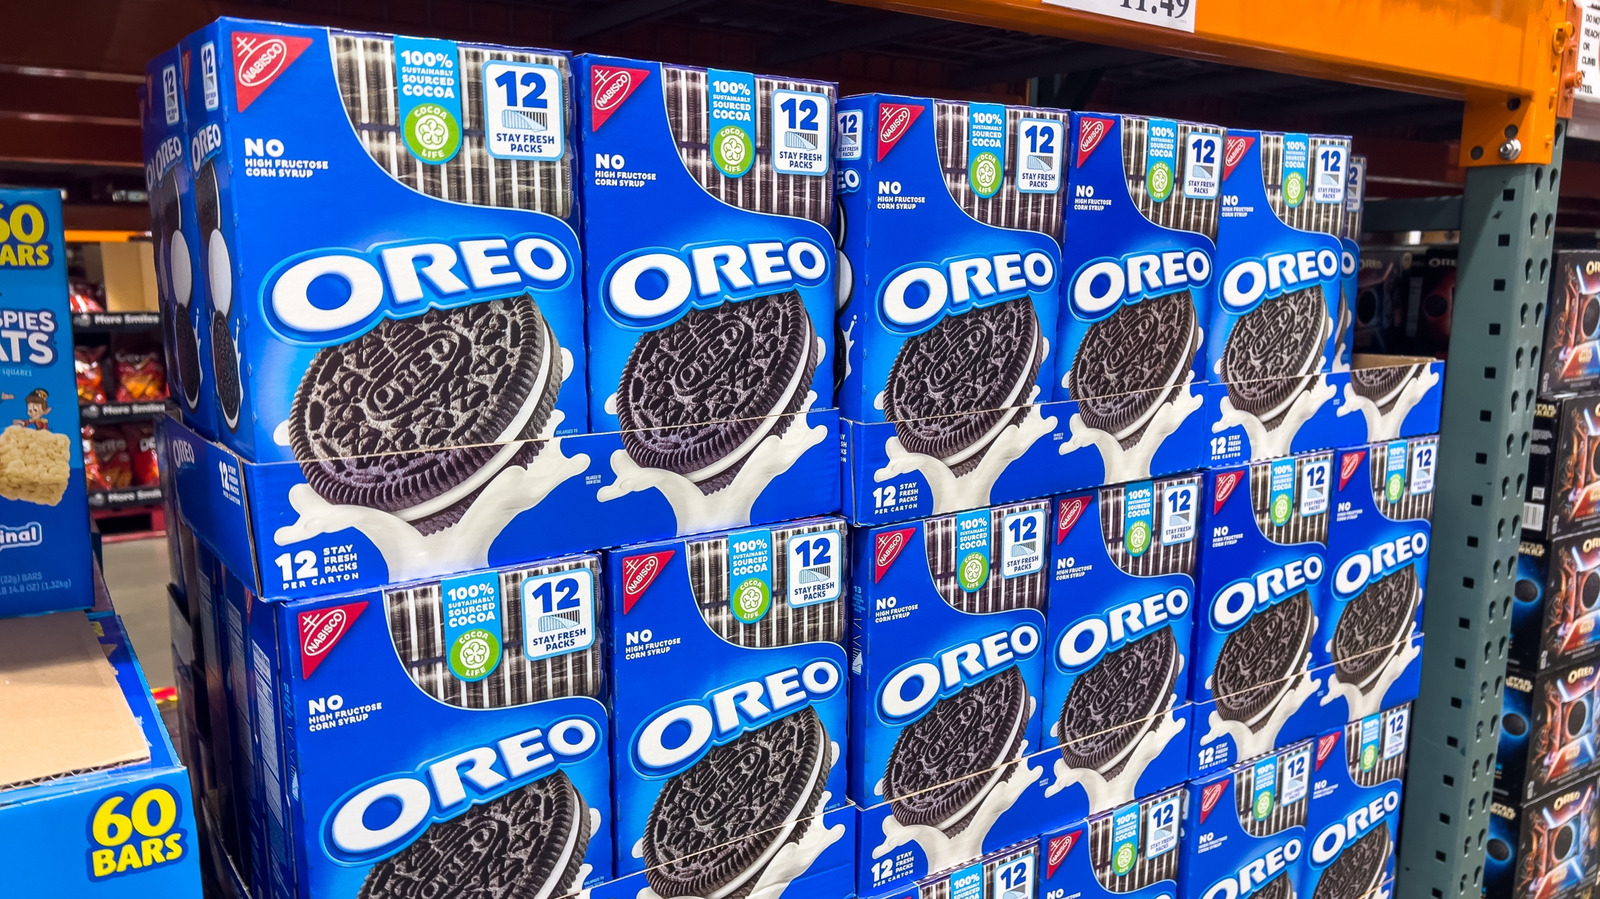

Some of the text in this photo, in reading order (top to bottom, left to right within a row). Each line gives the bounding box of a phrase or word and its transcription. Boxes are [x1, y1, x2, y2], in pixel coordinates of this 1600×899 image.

[203, 48, 213, 75] 12
[242, 43, 282, 83] NABISCO
[401, 50, 453, 68] 100%
[402, 67, 453, 76] SUSTAINABLY
[402, 75, 454, 86] SOURCED
[402, 84, 454, 98] COCOA
[495, 71, 547, 109] 12
[598, 74, 627, 108] NABISCO
[713, 80, 750, 96] 100%
[414, 106, 447, 119] COCOA
[713, 101, 751, 111] SOURCED
[713, 109, 750, 121] COCOA
[780, 98, 818, 131] 12
[840, 114, 857, 134] 12
[883, 110, 906, 140] NABISCO
[973, 112, 1002, 125] 100%
[497, 133, 554, 144] STAY FRESH
[720, 128, 744, 139] COCOA
[972, 138, 1001, 147] COCOA
[1025, 125, 1054, 153] 12
[192, 124, 221, 172] OREO
[245, 138, 284, 157] NO
[422, 149, 445, 159] LIFE
[511, 144, 542, 153] PACKS
[779, 151, 822, 161] STAY FRESH
[1150, 149, 1172, 157] COCOA
[1192, 139, 1215, 163] 12
[156, 136, 182, 181] OREO
[245, 158, 328, 169] HIGH FRUCTOSE
[596, 153, 624, 170] NO
[1320, 150, 1340, 171] 12
[246, 168, 313, 178] CORN SYRUP
[595, 170, 655, 180] HIGH FRUCTOSE
[724, 164, 741, 173] LIFE
[595, 178, 617, 186] CORN
[879, 181, 900, 195] NO
[1076, 185, 1093, 197] NO
[1223, 195, 1237, 205] NO
[272, 238, 567, 332] OREO
[611, 242, 826, 318] OREO
[1075, 251, 1209, 312] OREO
[1224, 250, 1337, 307] OREO
[884, 253, 1053, 325] OREO
[0, 311, 54, 332] PIES
[173, 440, 194, 468] OREO
[1210, 437, 1226, 455] 12
[1416, 449, 1432, 468] 12
[219, 461, 230, 490] 12
[1306, 466, 1325, 487] 12
[900, 482, 917, 490] STAY
[873, 486, 896, 508] 12
[1168, 489, 1191, 512] 12
[891, 504, 917, 512] CARTON
[1127, 508, 1149, 518] COCOA
[960, 517, 987, 530] 100%
[1009, 516, 1036, 542] 12
[1214, 526, 1227, 537] NO
[323, 544, 353, 555] STAY
[733, 538, 767, 553] 100%
[795, 538, 830, 567] 12
[879, 535, 900, 564] NABISCO
[959, 538, 986, 550] COCOA
[274, 550, 318, 582] 12
[324, 553, 357, 564] FRESH
[733, 555, 768, 567] SOURCED
[1057, 556, 1074, 570] NO
[1337, 532, 1427, 594] OREO
[324, 562, 357, 574] PACKS
[628, 559, 655, 592] NABISCO
[733, 563, 767, 576] COCOA
[283, 573, 358, 590] PER CARTON
[739, 580, 762, 590] COCOA
[794, 581, 834, 594] STAY FRESH
[447, 582, 494, 601] 100%
[532, 578, 580, 613] 12
[804, 590, 826, 601] PACKS
[1215, 557, 1323, 626] OREO
[448, 595, 494, 608] SUSTAINABLY
[448, 602, 495, 617] SOURCED
[876, 596, 896, 611] NO
[449, 610, 495, 628] COCOA
[743, 611, 759, 619] LIFE
[307, 613, 342, 653] NABISCO
[459, 631, 488, 643] COCOA
[533, 627, 586, 645] STAY FRESH
[626, 628, 652, 646] NO
[1059, 590, 1188, 667] OREO
[546, 638, 575, 651] PACKS
[625, 637, 680, 653] HIGH FRUCTOSE
[626, 646, 670, 660] CORN SYRUP
[465, 666, 486, 676] LIFE
[882, 627, 1038, 717] OREO
[1568, 666, 1594, 684] OREO
[308, 694, 343, 716] NO
[309, 702, 382, 725] HIGH FRUCTOSE
[309, 713, 368, 732] CORN SYRUP
[638, 662, 838, 767] OREO
[1389, 715, 1403, 734] 12
[1198, 747, 1214, 765] 12
[1287, 757, 1305, 778] 12
[331, 721, 595, 851] OREO
[1554, 791, 1580, 810] OREO
[92, 788, 176, 846] 60
[1153, 804, 1173, 828] 12
[1313, 792, 1399, 863] OREO
[92, 833, 182, 877] BARS
[871, 859, 893, 882] 12
[1000, 863, 1026, 890] 12
[1200, 840, 1301, 899] OREO
